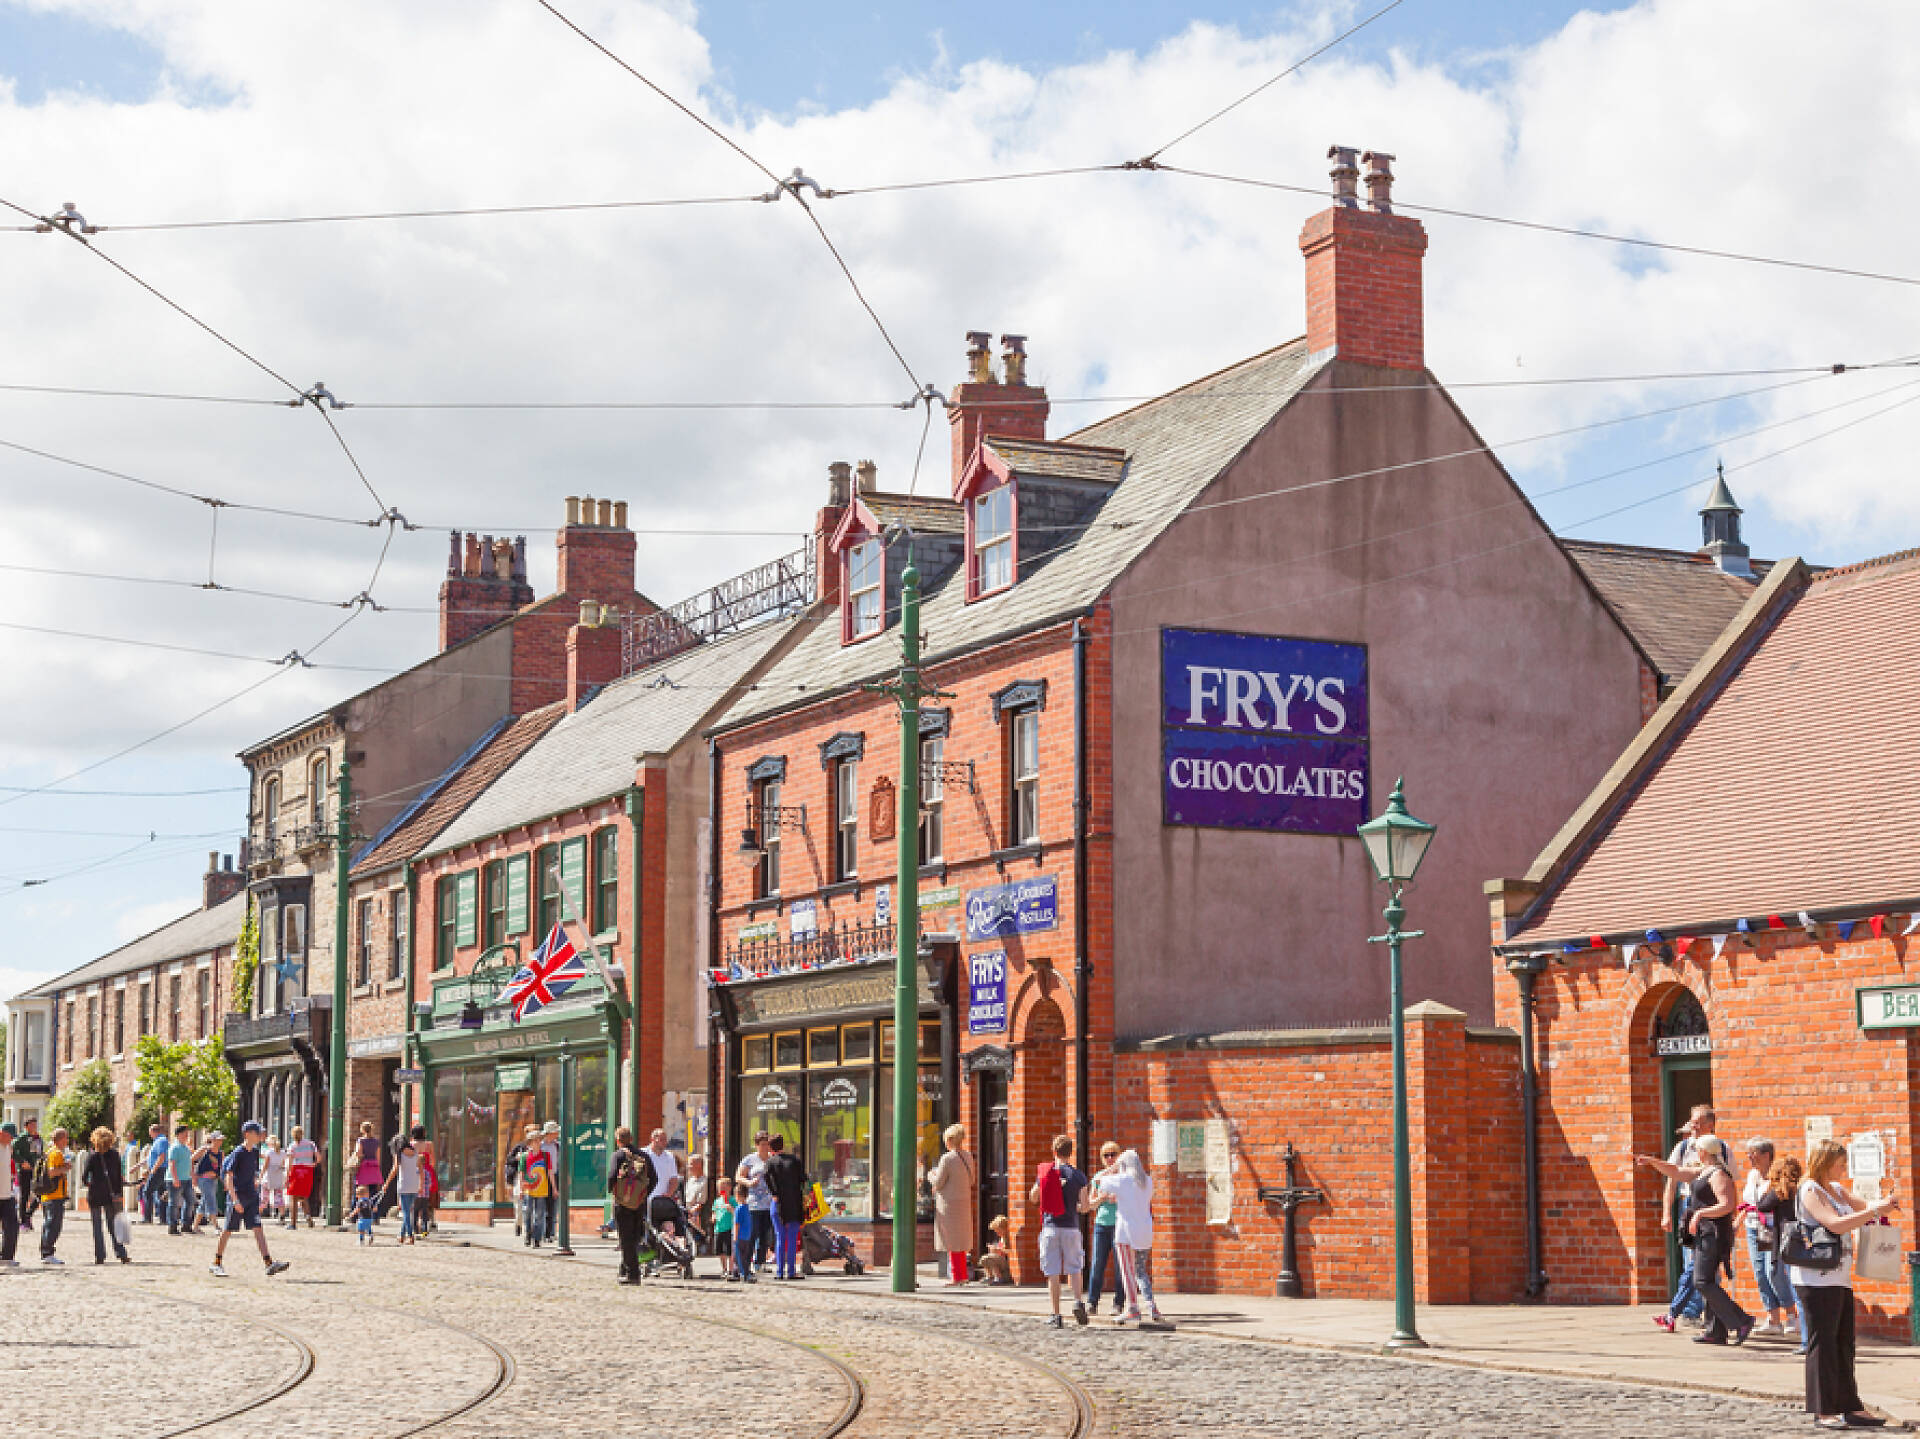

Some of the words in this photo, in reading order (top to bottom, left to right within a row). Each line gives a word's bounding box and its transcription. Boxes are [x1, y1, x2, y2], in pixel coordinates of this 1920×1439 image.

[1185, 665, 1347, 735] FRY'S
[1169, 757, 1365, 800] CHOCOLATES
[1882, 992, 1919, 1018] BEA
